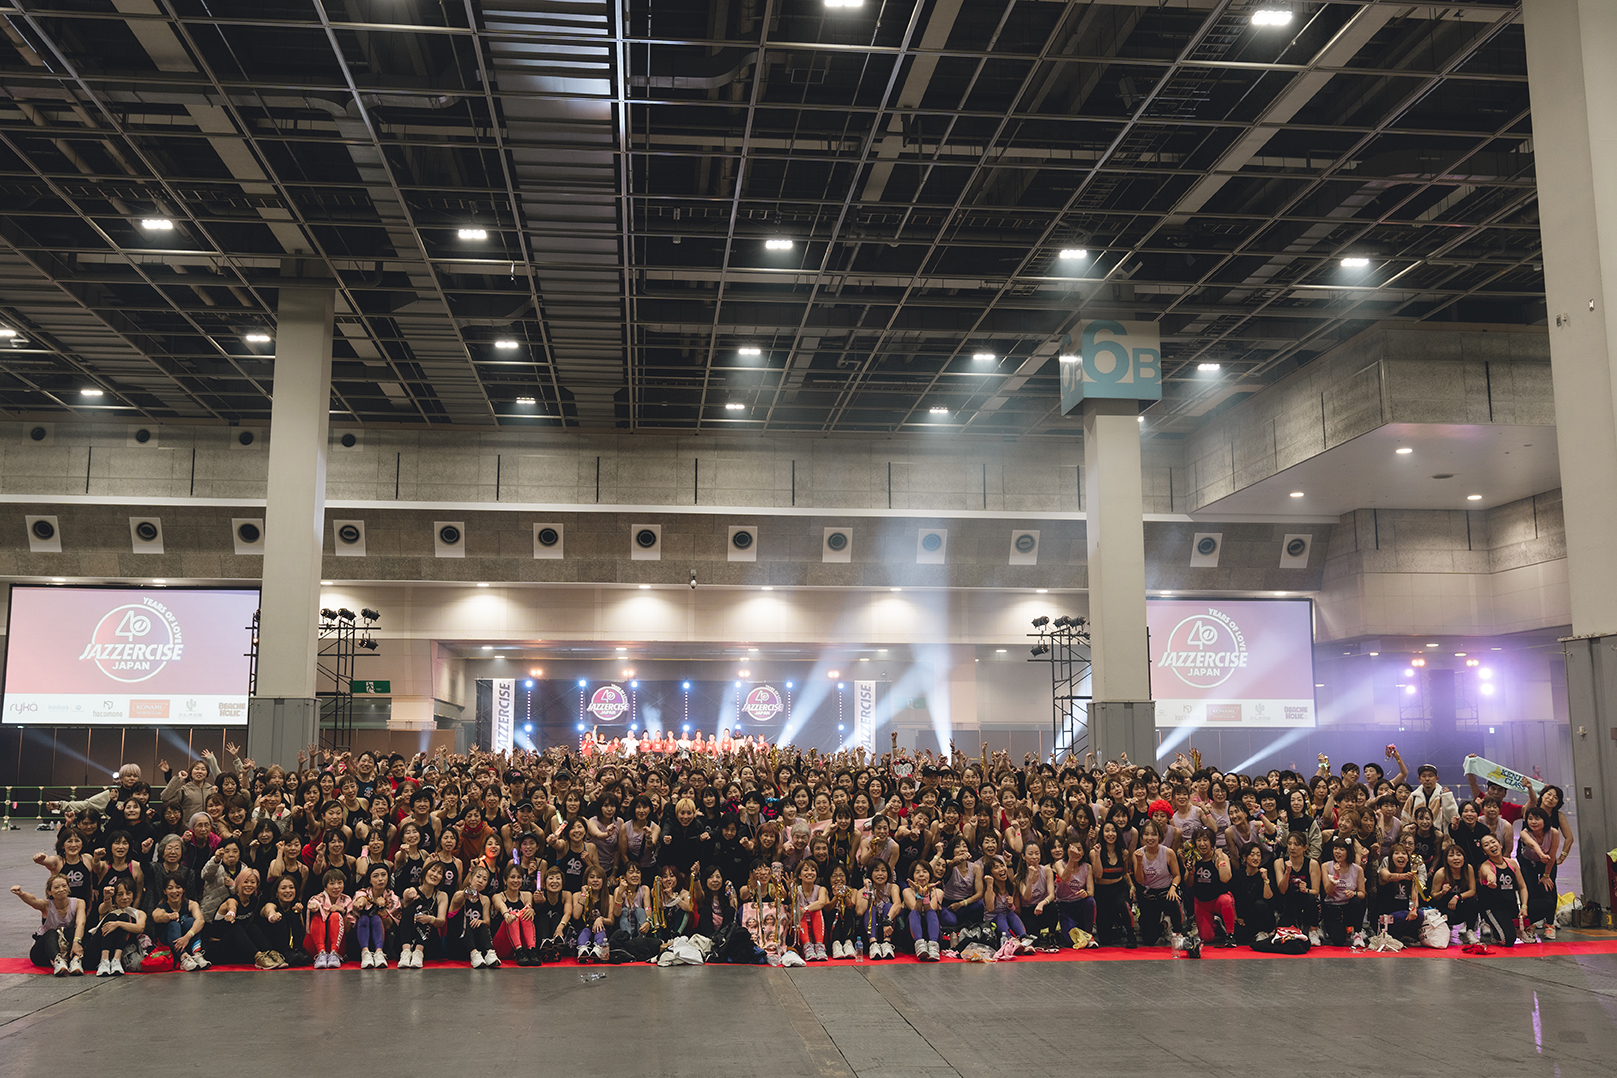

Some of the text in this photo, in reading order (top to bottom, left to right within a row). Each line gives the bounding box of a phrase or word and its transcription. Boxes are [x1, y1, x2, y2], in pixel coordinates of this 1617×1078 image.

[143, 596, 183, 644] YEARS OF LOVE
[1208, 607, 1246, 651] YEARS OF LOVE
[79, 643, 184, 661] JAZZERCISE
[112, 661, 151, 670] JAPAN
[1157, 651, 1248, 668] JAZZERCISE
[1187, 668, 1220, 677] JAPAN
[587, 703, 629, 711] JAZZERCISE
[742, 703, 784, 712] JAZZERCISE
[1501, 769, 1522, 781] KENJ
[1196, 866, 1212, 879] 40
[1499, 873, 1513, 885] 40
